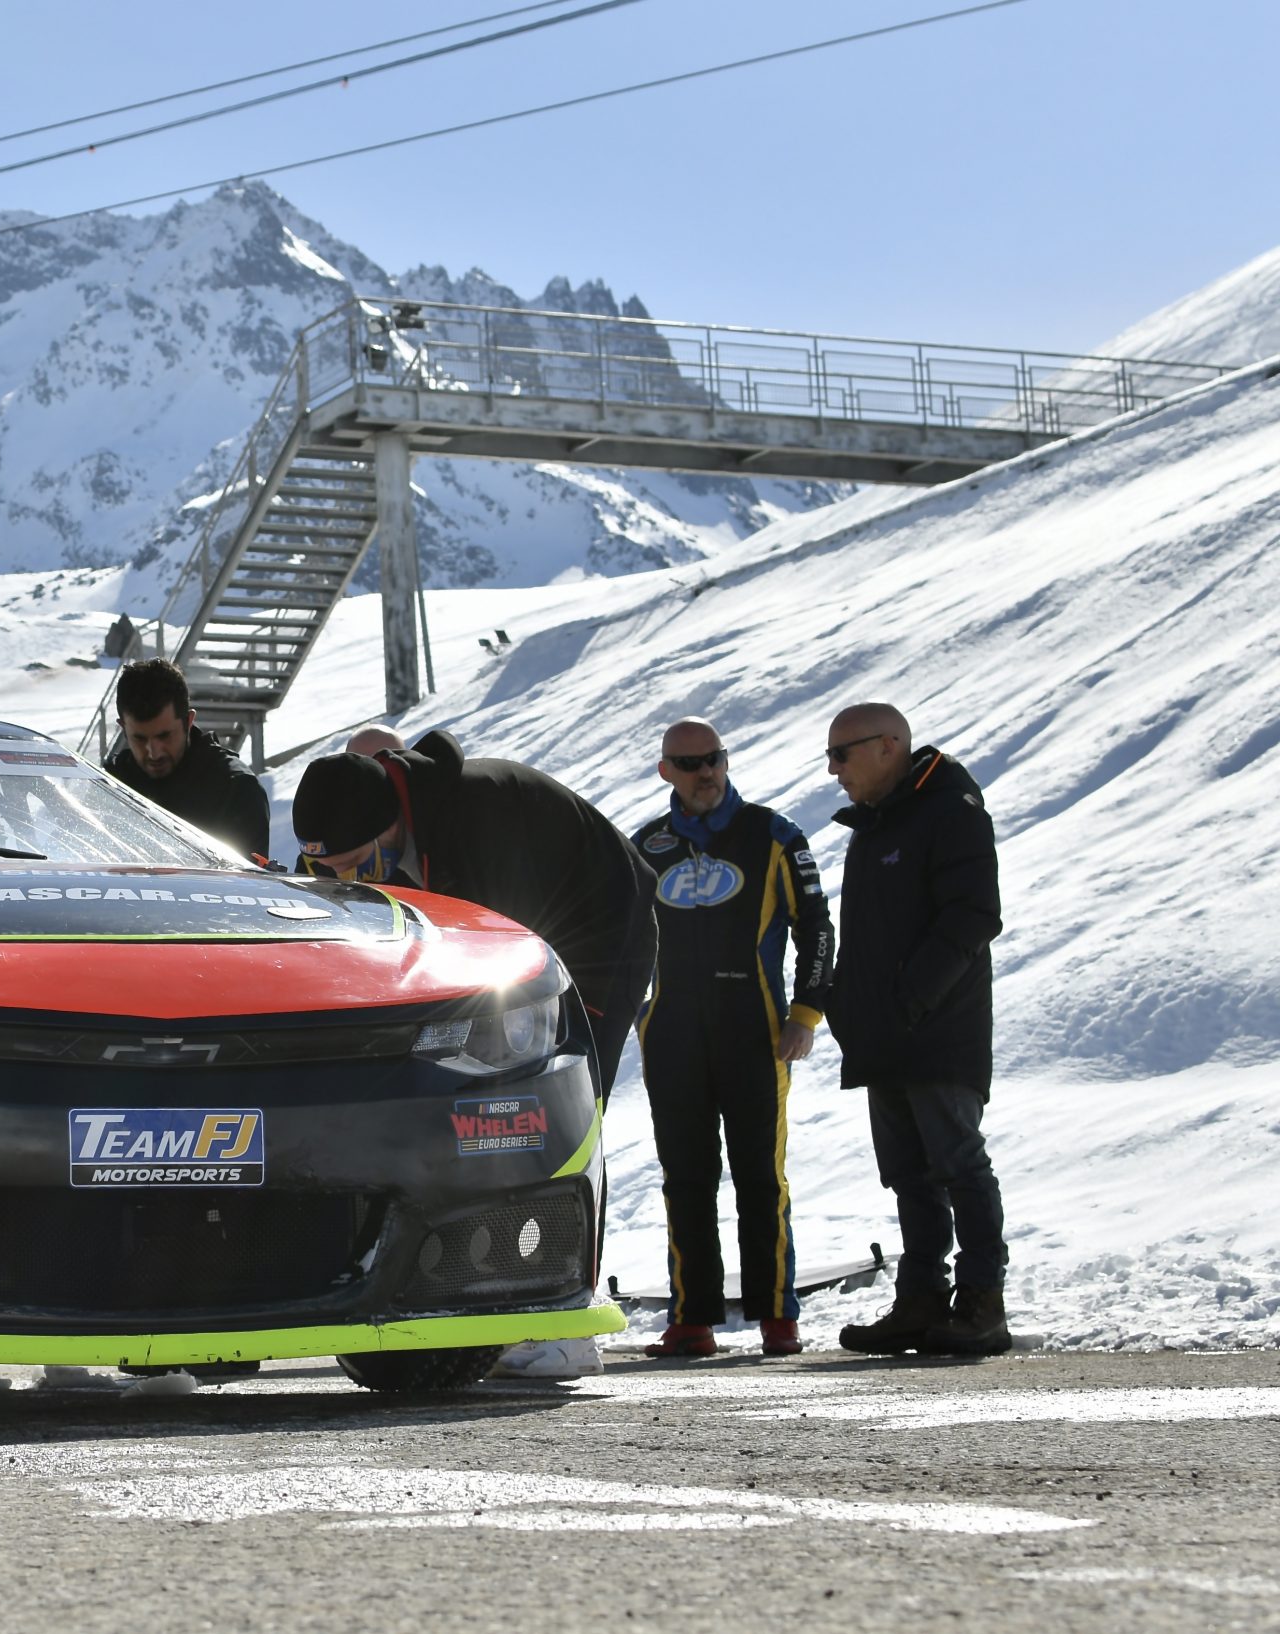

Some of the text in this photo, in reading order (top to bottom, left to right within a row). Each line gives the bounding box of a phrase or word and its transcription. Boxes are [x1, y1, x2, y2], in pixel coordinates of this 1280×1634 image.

[489, 1102, 519, 1113] NASCAR
[451, 1107, 547, 1138] WHELEN
[478, 1136, 527, 1149] EURO SERIES
[92, 1168, 242, 1182] MOTORSPORTS
